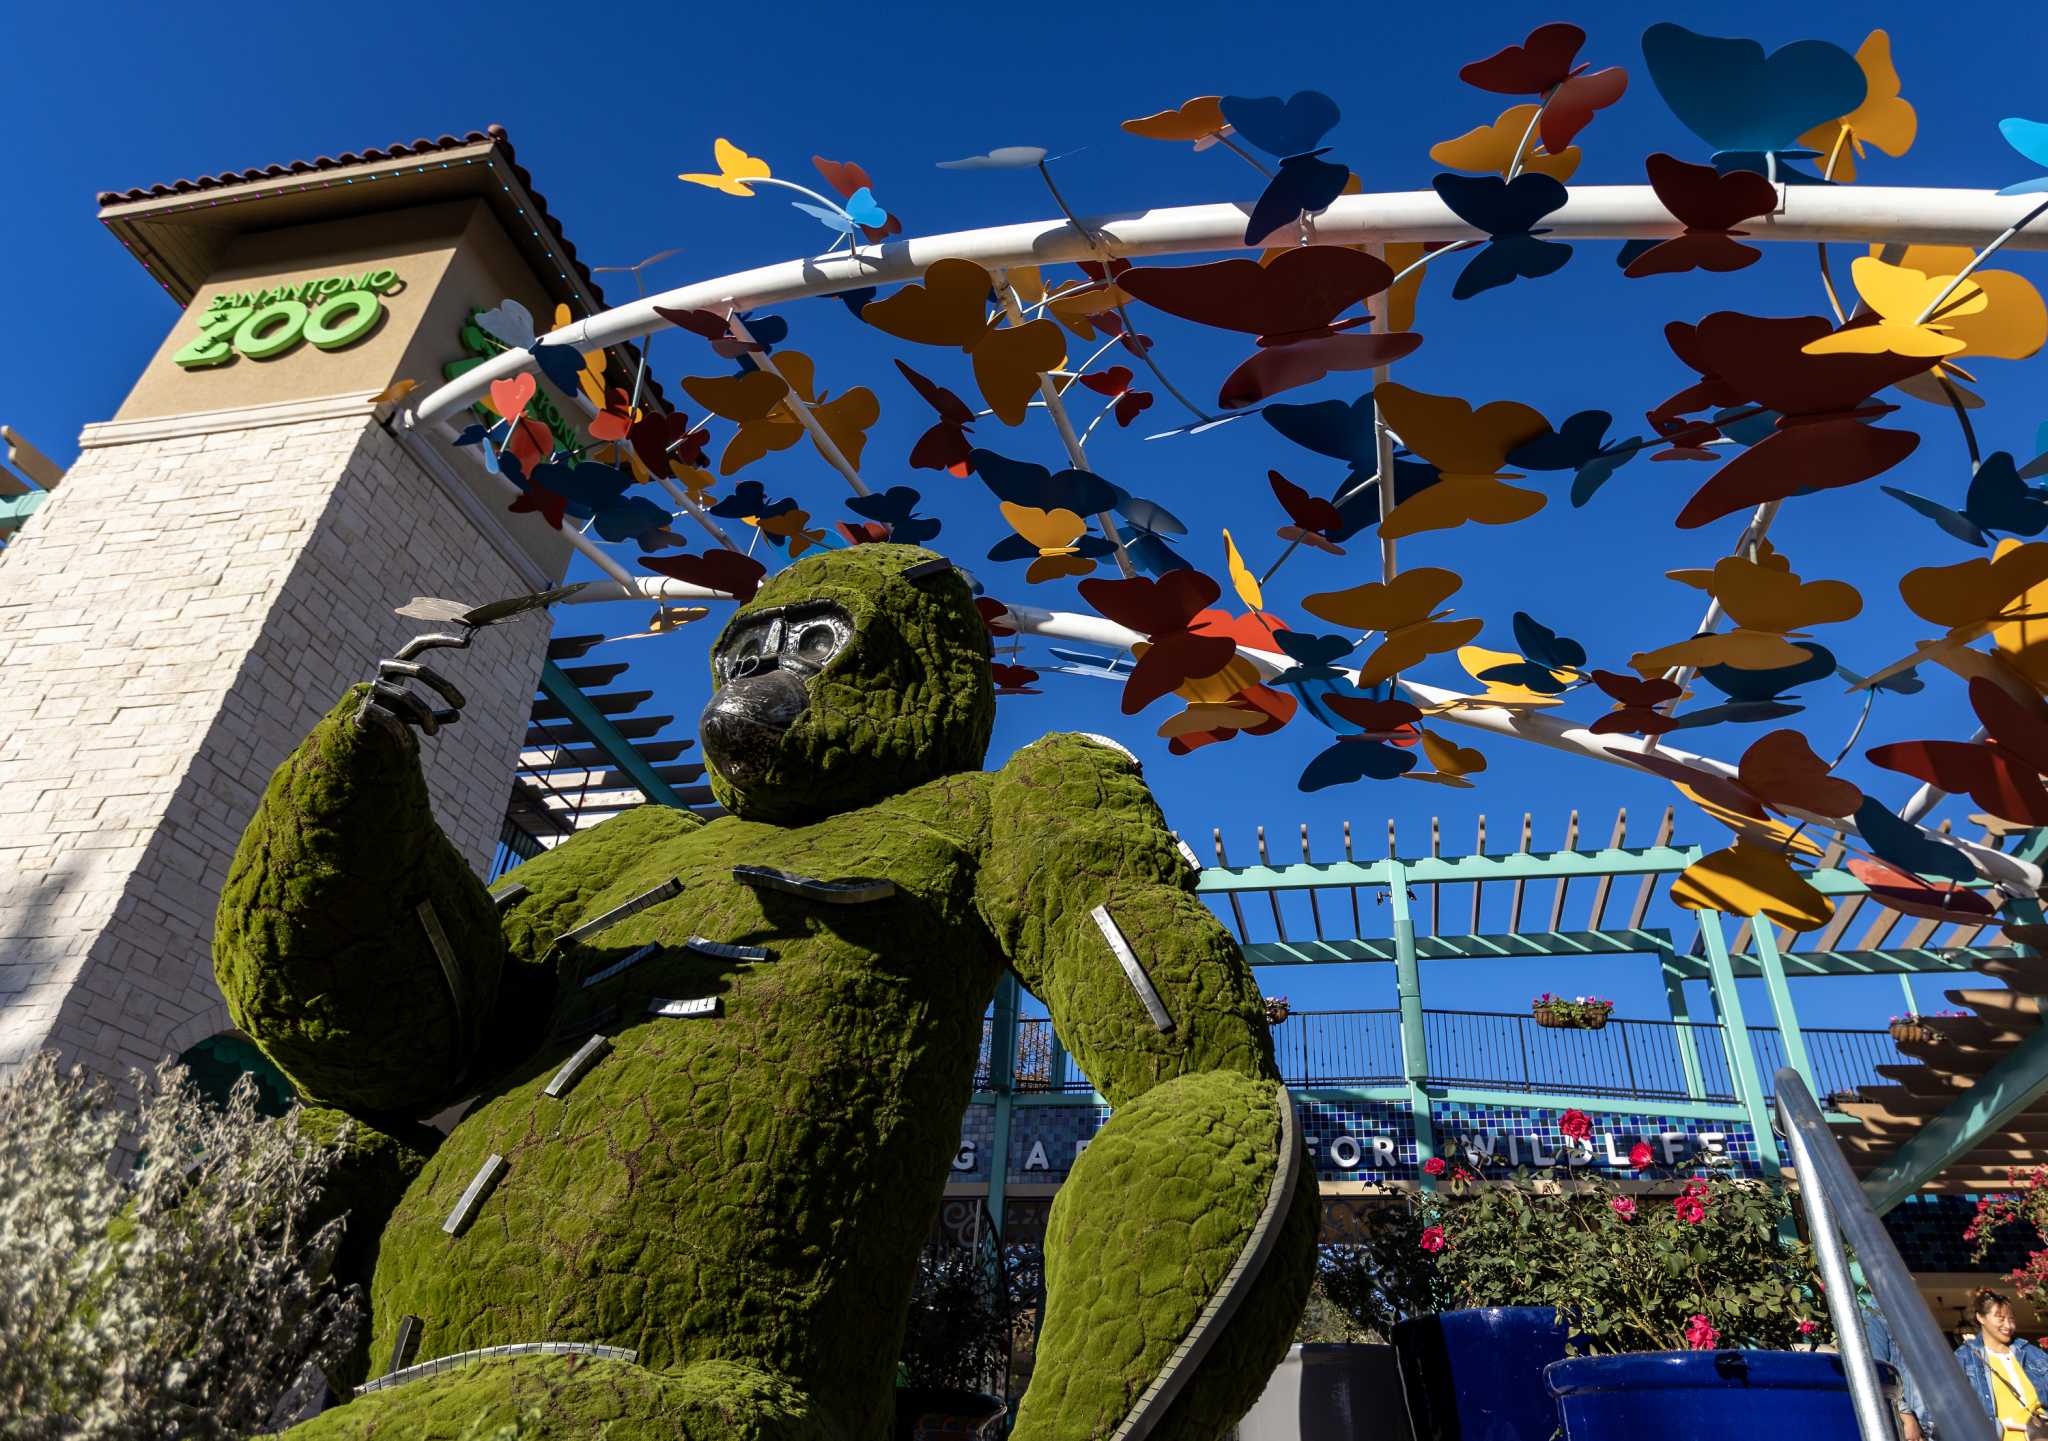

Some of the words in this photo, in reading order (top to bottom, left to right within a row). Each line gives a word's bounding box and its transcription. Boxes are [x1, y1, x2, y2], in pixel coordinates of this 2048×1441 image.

[208, 290, 264, 311] SAN
[266, 268, 399, 302] ANTONIO
[173, 290, 381, 367] ZOO
[1025, 1140, 1049, 1170] A
[1459, 1132, 1729, 1167] WILDLFE
